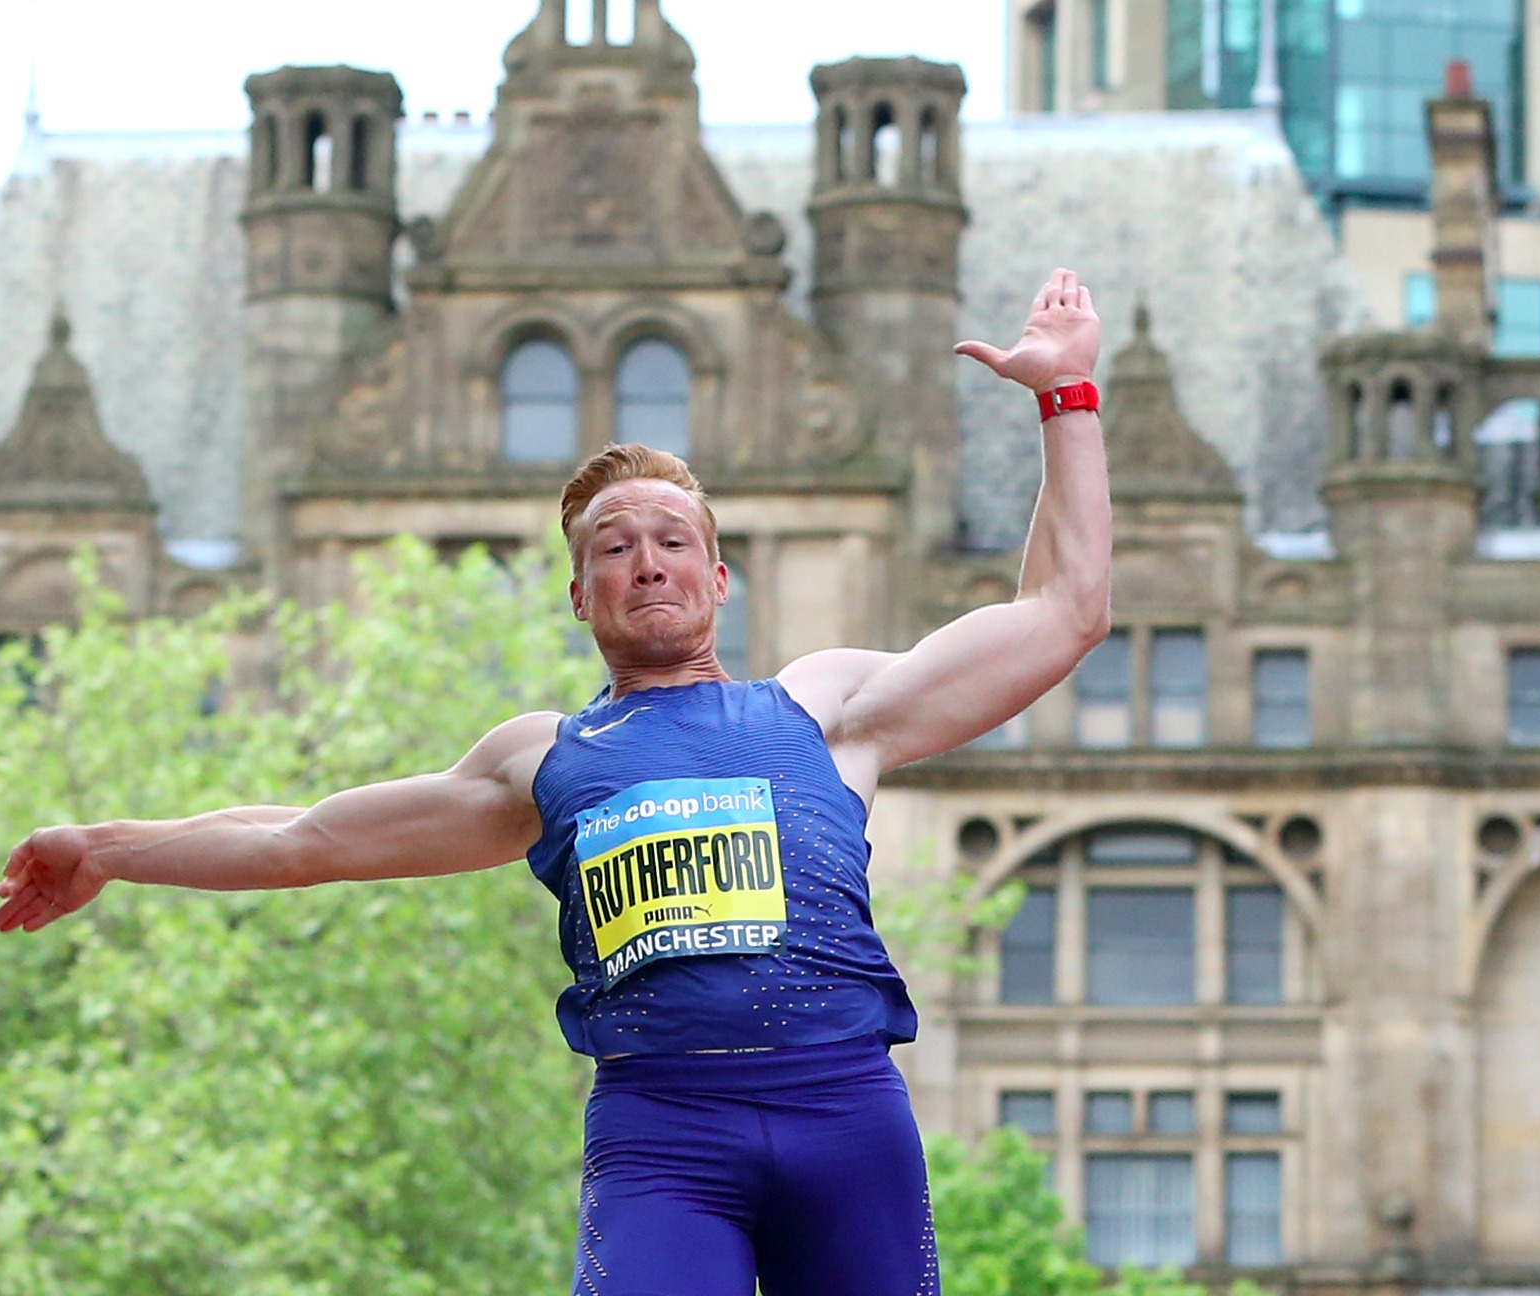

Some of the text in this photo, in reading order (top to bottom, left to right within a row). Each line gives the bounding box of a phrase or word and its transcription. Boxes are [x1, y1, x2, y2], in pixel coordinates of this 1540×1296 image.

[583, 791, 767, 839] The co-op bank
[585, 831, 776, 929] RUTHERFORD
[643, 905, 694, 926] PUMA
[605, 925, 780, 980] MANCHESTER
